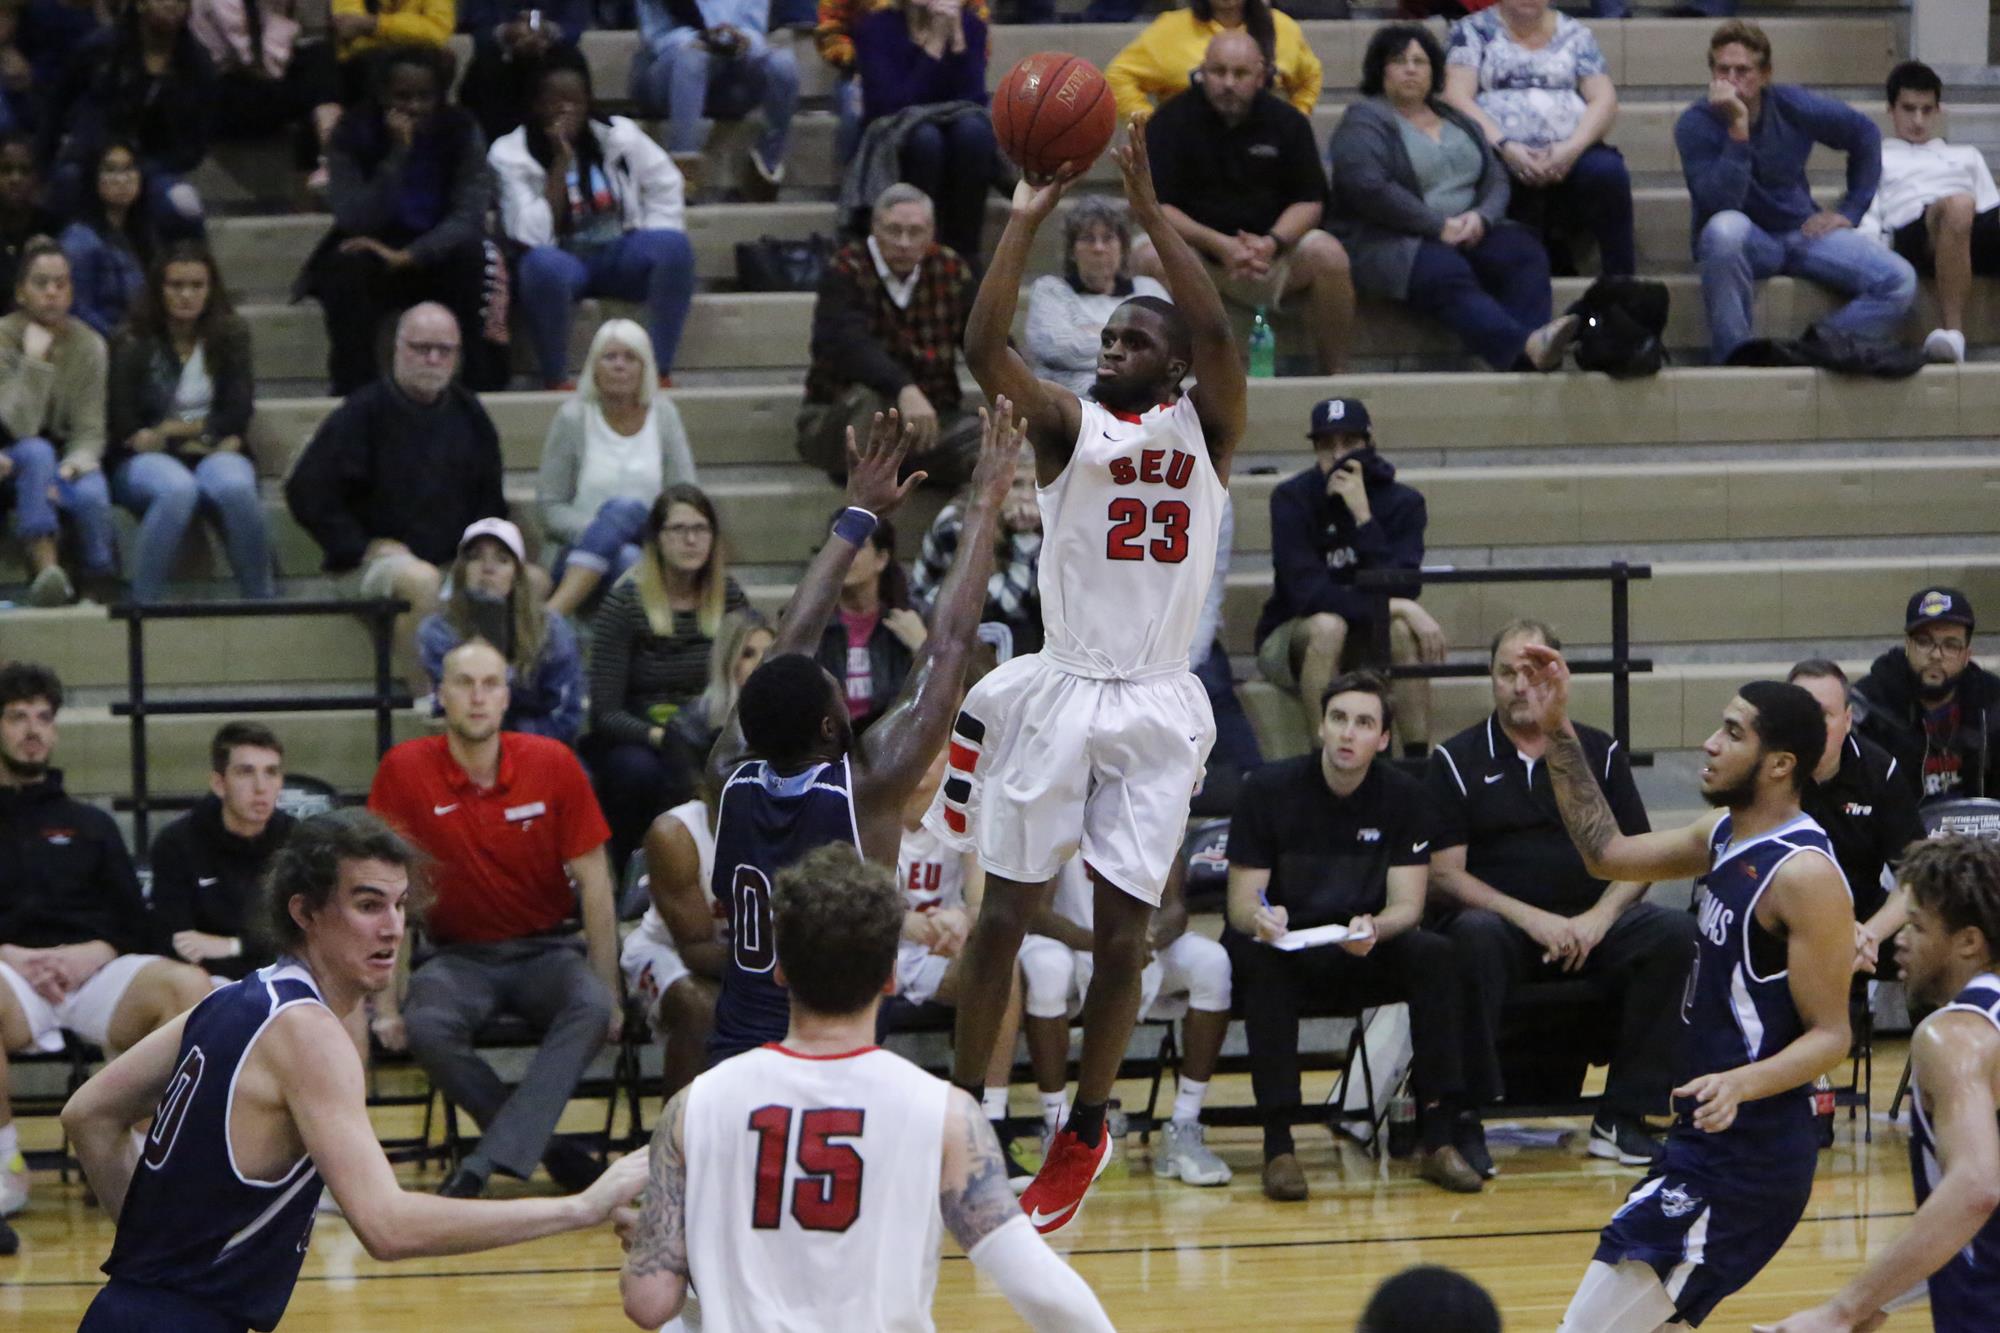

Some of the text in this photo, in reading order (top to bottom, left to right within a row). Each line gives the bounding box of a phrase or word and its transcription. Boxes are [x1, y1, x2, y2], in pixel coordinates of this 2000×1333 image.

[1109, 449, 1196, 489] SEU
[1107, 497, 1190, 563] 23
[908, 862, 943, 892] EU
[747, 1104, 865, 1233] 15
